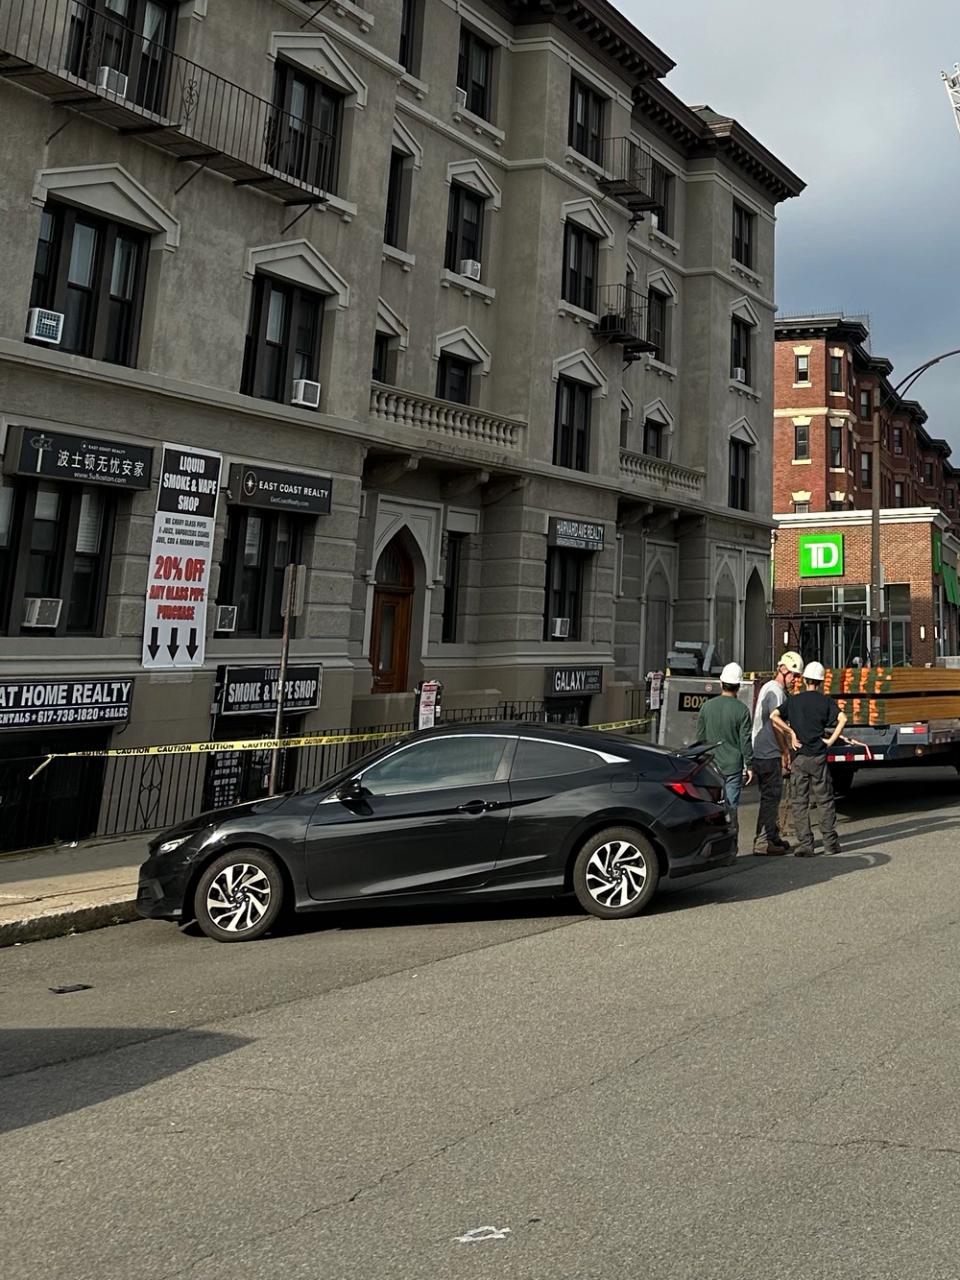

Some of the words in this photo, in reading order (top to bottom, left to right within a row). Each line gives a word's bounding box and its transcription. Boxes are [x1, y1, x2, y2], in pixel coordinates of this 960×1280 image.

[57, 449, 144, 477] 波士顿无忧安家
[180, 455, 205, 474] LIQUID
[163, 472, 191, 491] SMOKE
[191, 479, 197, 492] &
[198, 478, 217, 495] VAPE
[259, 480, 278, 491] EAST
[279, 483, 302, 494] COAST
[303, 487, 329, 498] REALTY
[178, 495, 200, 512] SHOP
[804, 542, 839, 569] TD
[154, 555, 182, 580] 20%
[184, 557, 206, 582] OFF
[149, 585, 166, 600] ANY
[166, 586, 189, 601] GLASS
[189, 587, 205, 602] PIPE
[157, 604, 195, 620] PURCHASE
[555, 671, 586, 691] GALAXY
[20, 684, 68, 706] HOME
[71, 682, 131, 704] REALTY
[228, 682, 261, 703] SMOKE
[263, 685, 270, 701] &
[271, 681, 294, 700] VPE
[294, 680, 317, 699] SHOP
[683, 695, 709, 708] BOX
[37, 707, 99, 723] 617-738-1820
[105, 707, 129, 718] SALES
[116, 746, 150, 755] CAUTION
[157, 744, 192, 753] CAUTION
[198, 743, 234, 751] CAUTION
[242, 740, 278, 749] CAUTION
